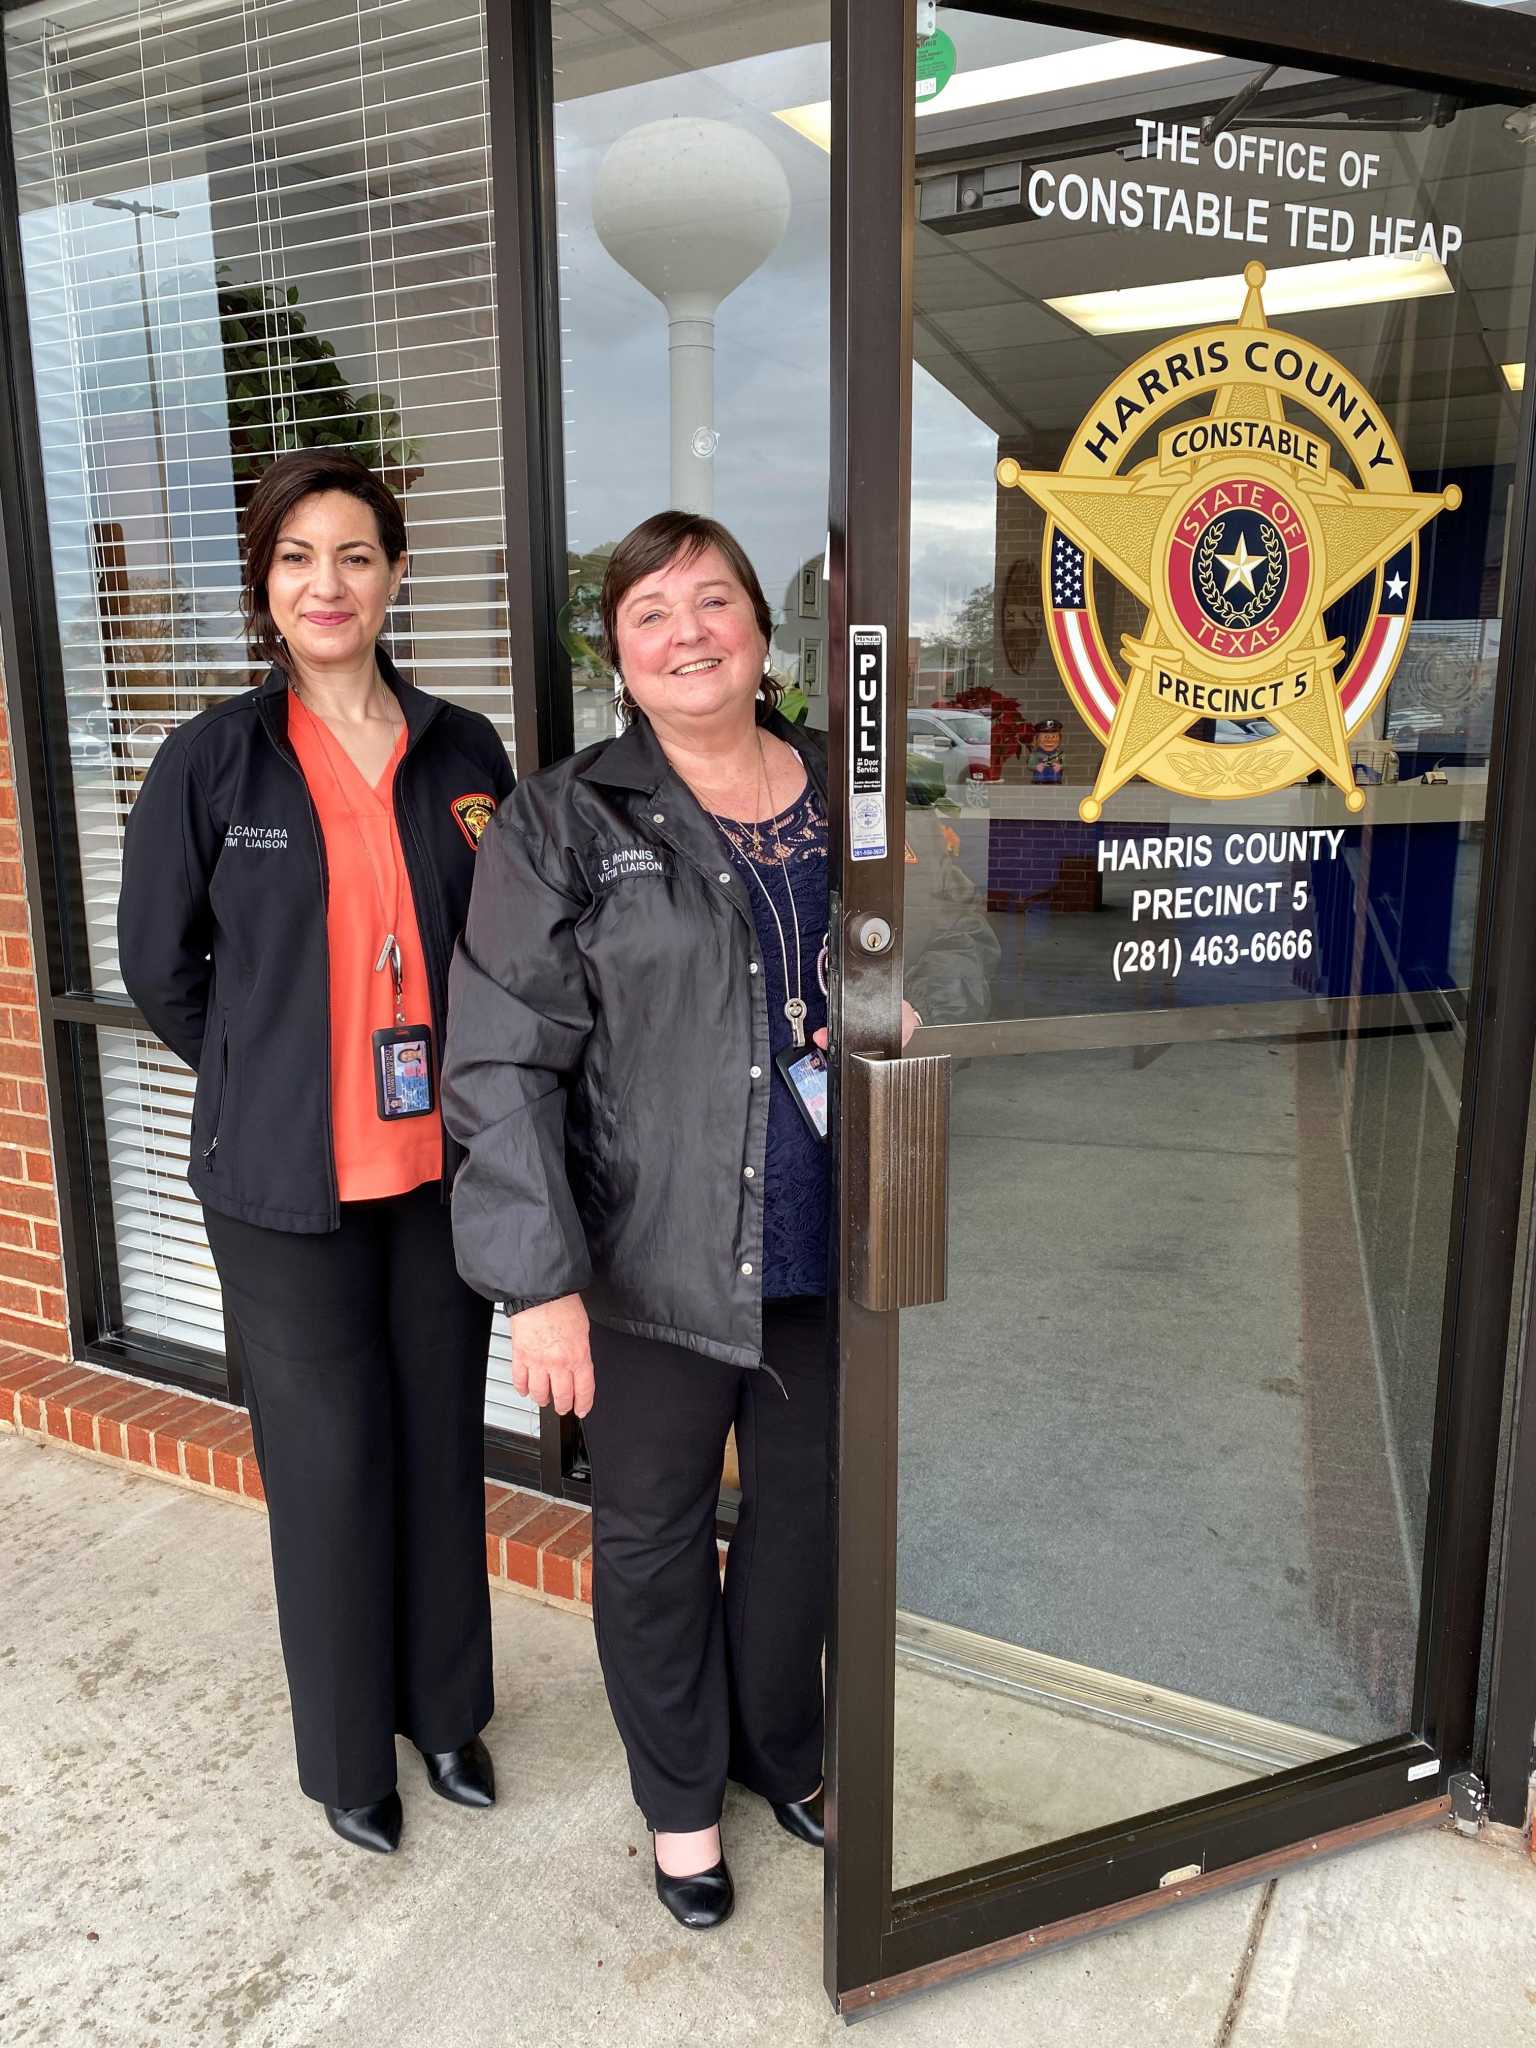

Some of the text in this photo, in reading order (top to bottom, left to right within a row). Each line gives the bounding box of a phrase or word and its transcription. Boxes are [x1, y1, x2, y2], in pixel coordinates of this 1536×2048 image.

[1135, 118, 1380, 189] THE OFFICE OF
[1028, 169, 1463, 265] CONSTABLE TED HEAP
[1084, 340, 1394, 471] HARRIS COUNTY
[1171, 421, 1319, 469] CONSTABLE
[1182, 483, 1303, 540] STATE OF
[1194, 620, 1282, 656] TEXAS
[859, 653, 877, 752] PULL
[1157, 670, 1308, 713] PRECINCT 5
[864, 758, 879, 766] Door
[226, 825, 288, 839] LCANTARA
[245, 838, 288, 849] LIAISON
[1098, 829, 1345, 873] HARRIS COUNTY
[620, 861, 663, 873] LIAISON
[1132, 881, 1308, 922] PRECINCT 5
[1112, 929, 1313, 981] (281) 463-6666
